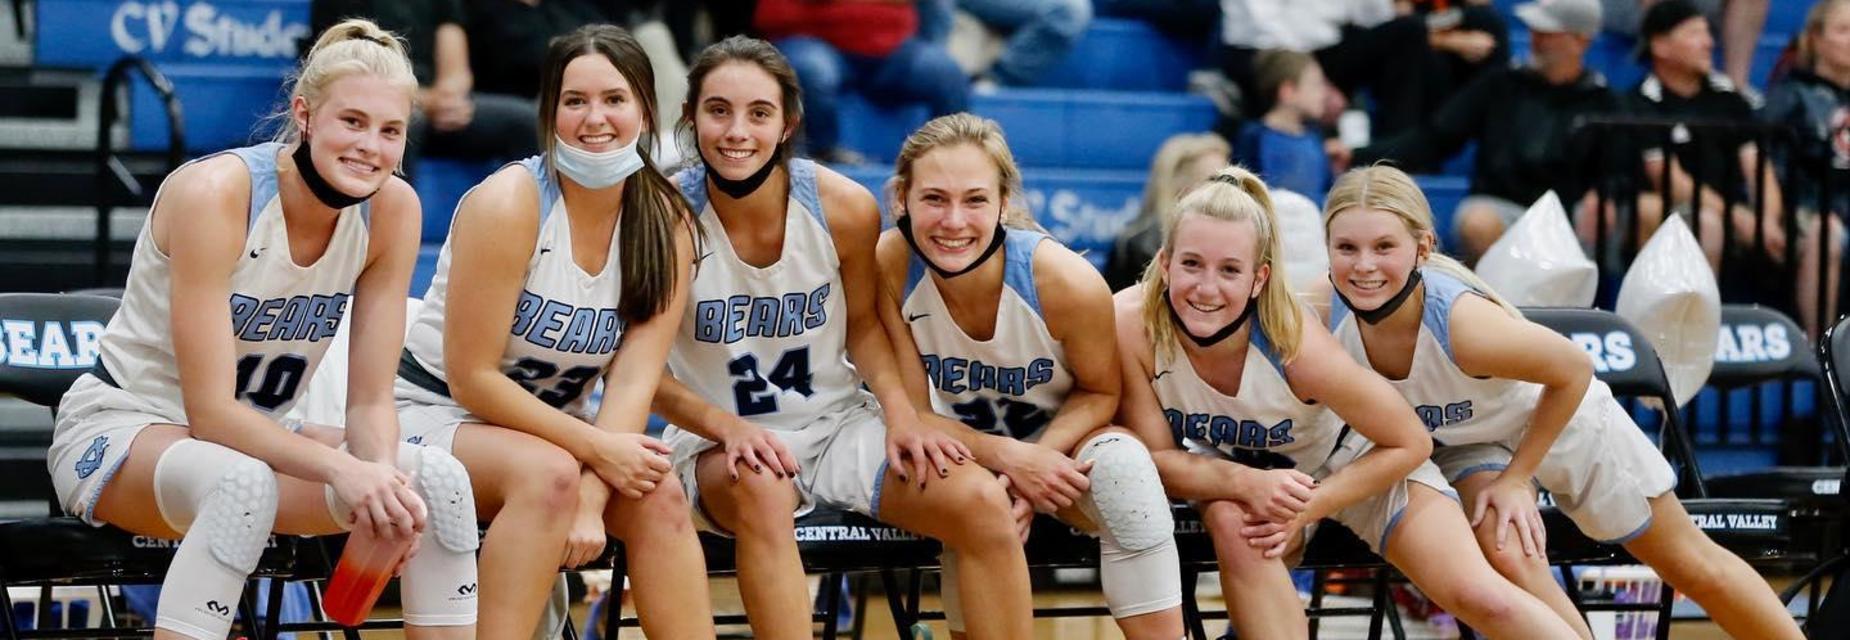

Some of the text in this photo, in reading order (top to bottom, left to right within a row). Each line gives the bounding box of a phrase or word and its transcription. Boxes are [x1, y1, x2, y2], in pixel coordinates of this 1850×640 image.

[111, 2, 178, 53] CV
[511, 289, 624, 354] BEAR
[696, 283, 831, 344] BEARS
[727, 344, 816, 417] 24
[794, 526, 871, 541] CENTRAL
[1727, 514, 1777, 529] VALLEY
